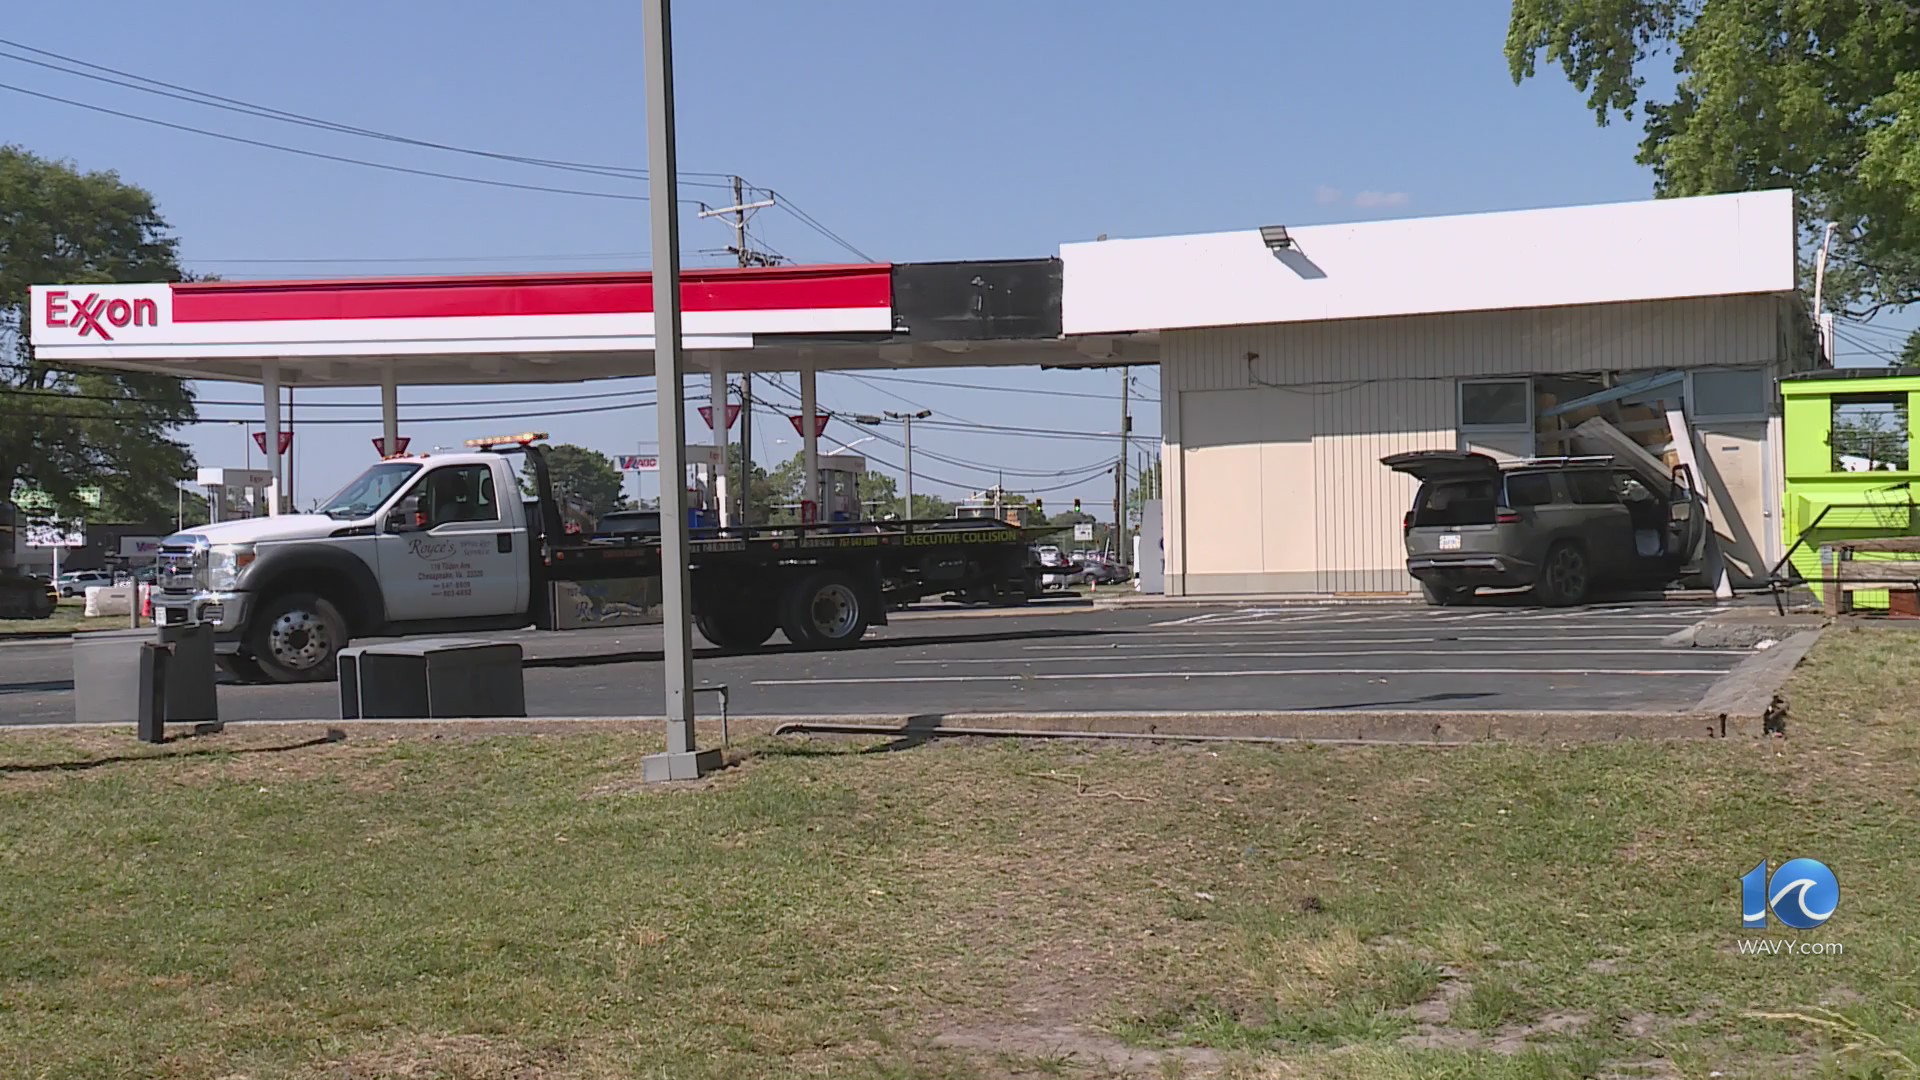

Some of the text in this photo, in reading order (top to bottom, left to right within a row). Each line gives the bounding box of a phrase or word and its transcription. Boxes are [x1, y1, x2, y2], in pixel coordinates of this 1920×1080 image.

[46, 290, 157, 341] Exxon
[408, 538, 457, 562] Royce's
[903, 531, 1017, 546] EXECUTIVE COLLISION
